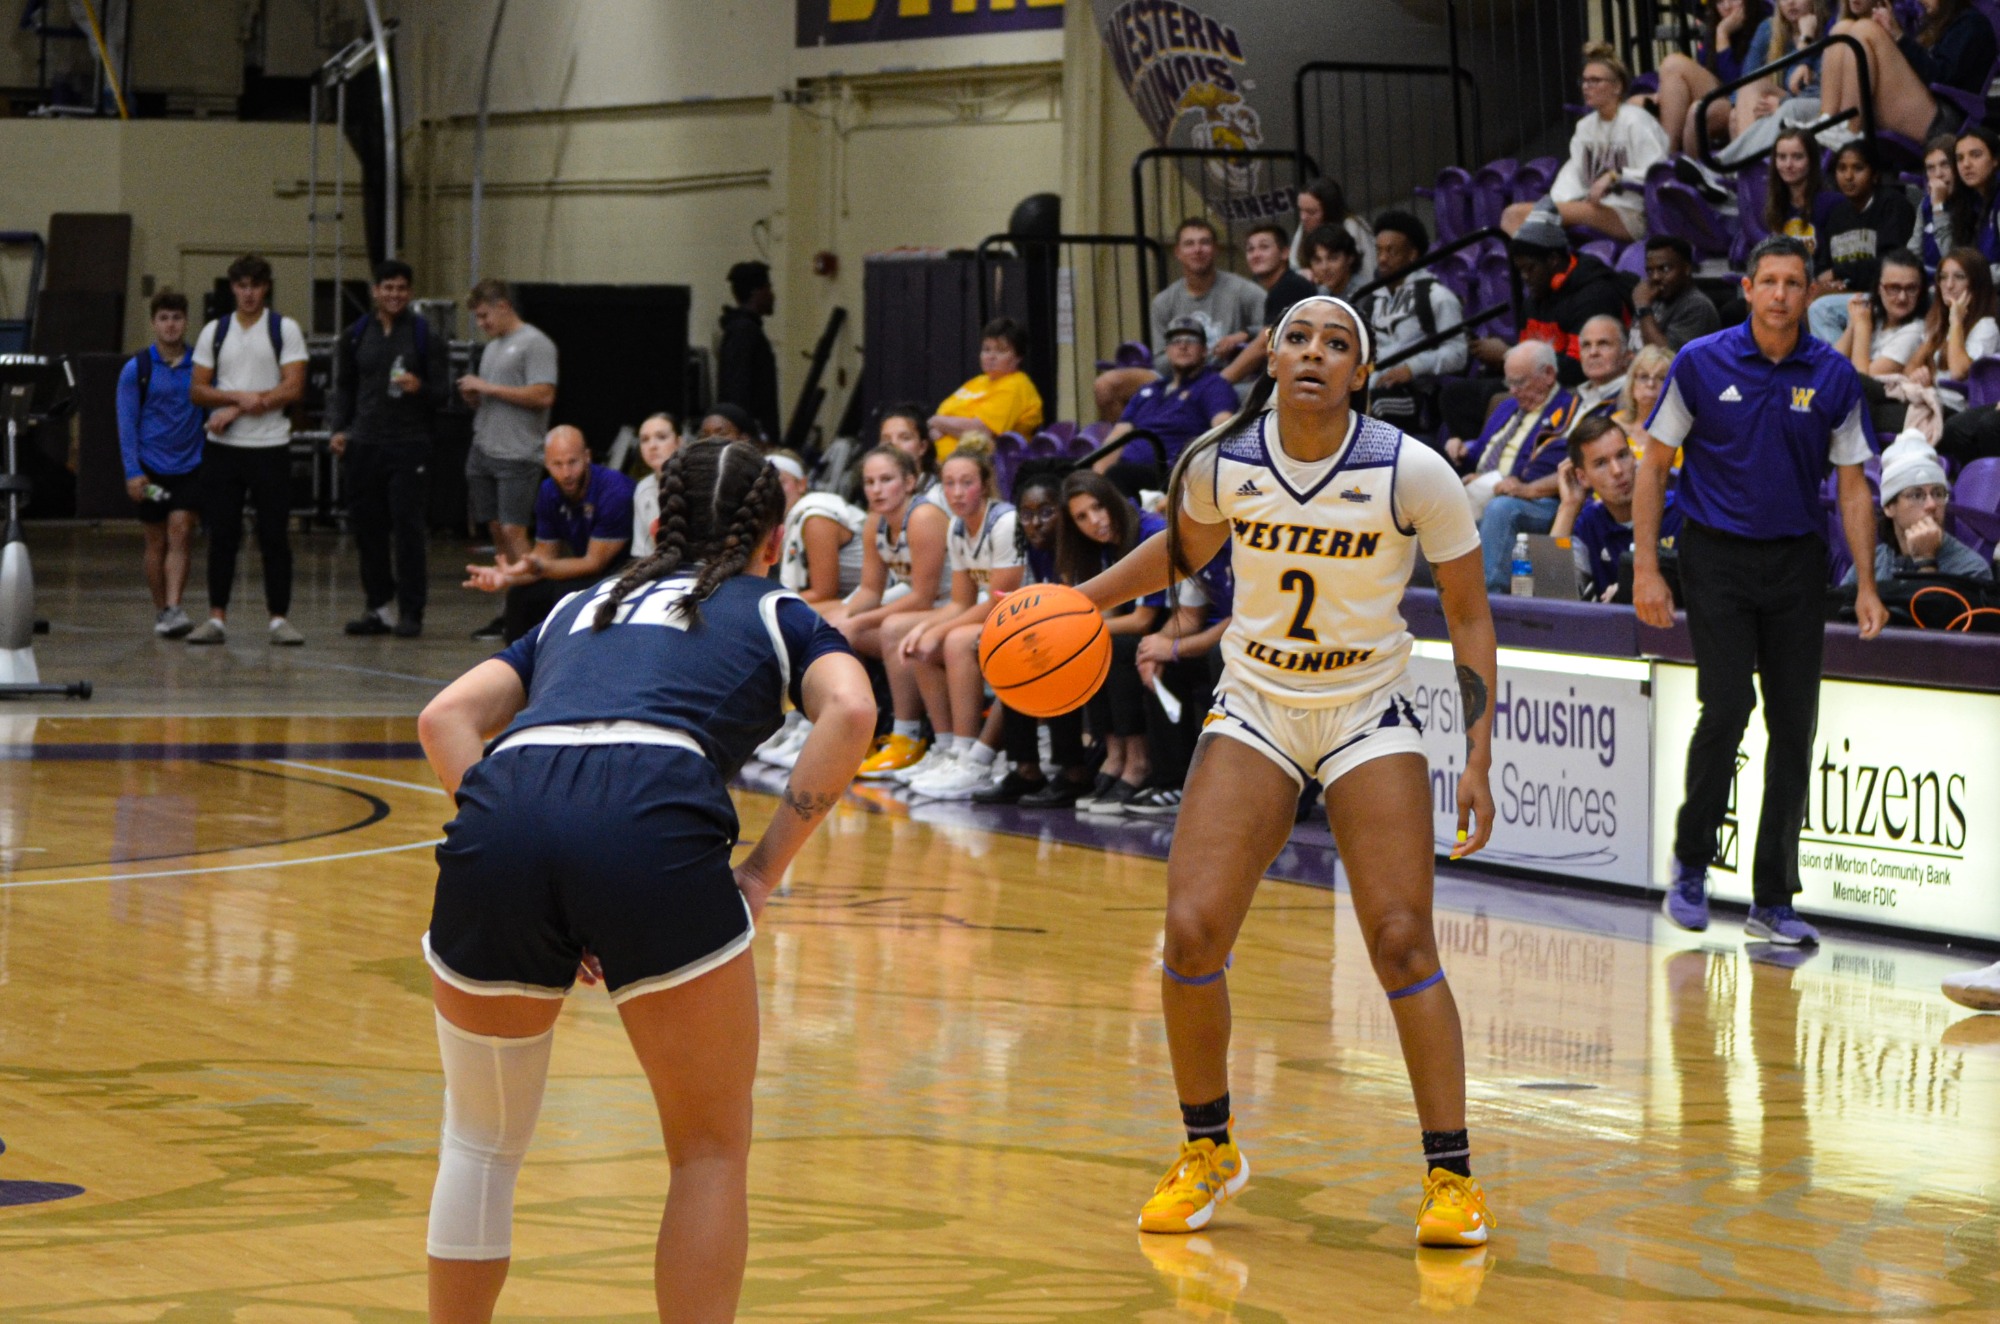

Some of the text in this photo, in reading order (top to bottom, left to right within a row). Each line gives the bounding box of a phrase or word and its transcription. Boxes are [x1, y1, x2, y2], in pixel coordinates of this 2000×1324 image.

[1231, 517, 1383, 558] WESTERN
[568, 577, 699, 636] 22
[1278, 567, 1319, 644] 2
[1492, 680, 1616, 767] Housing
[1501, 762, 1617, 838] Services
[1801, 737, 1967, 851] tizens
[1799, 850, 1951, 887] ision of Morton Community Bank
[1833, 881, 1897, 907] Member FDIC
